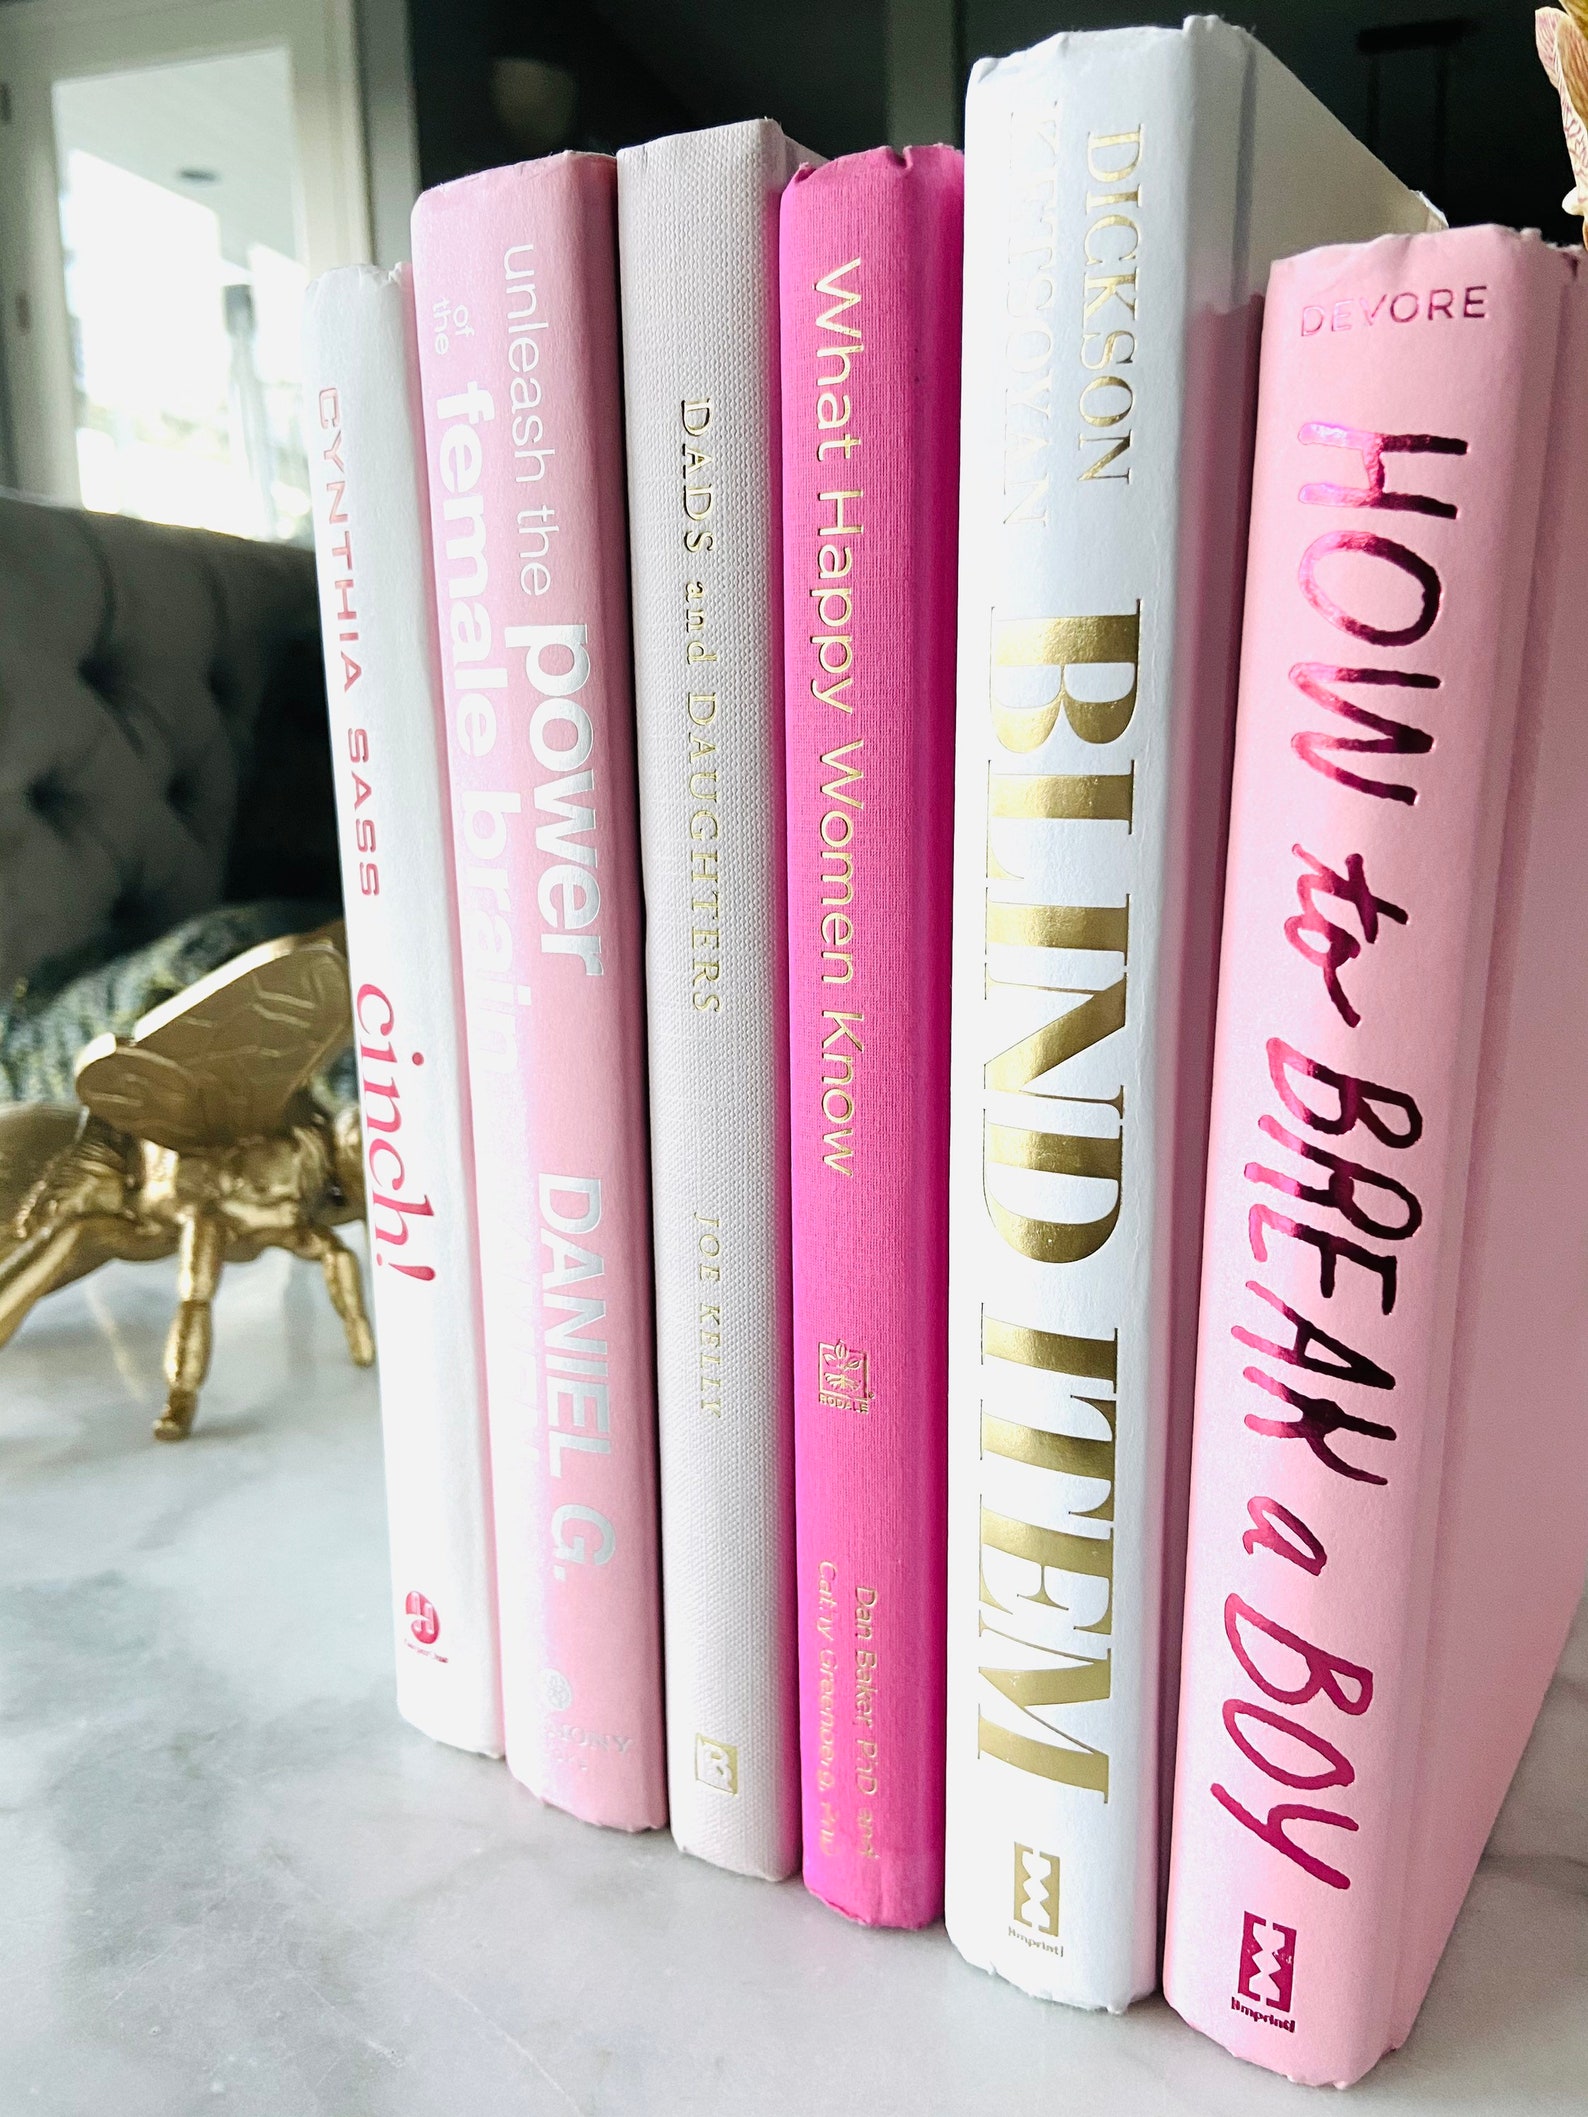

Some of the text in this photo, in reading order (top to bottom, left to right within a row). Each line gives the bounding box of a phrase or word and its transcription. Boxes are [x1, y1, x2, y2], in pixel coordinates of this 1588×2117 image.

[431, 296, 450, 356] the
[450, 304, 475, 338] of
[1076, 123, 1145, 485] DICKSON
[1300, 285, 1489, 338] DEVORE
[318, 388, 380, 896] CYNTHIA SASS
[437, 380, 532, 1075] female brain
[503, 243, 604, 976] unleash the power
[681, 397, 720, 1013] DADS and DAUGHTERS
[810, 257, 865, 1178] What Happy Women Know
[1288, 421, 1470, 807] HOW
[1284, 843, 1410, 1029] to
[356, 983, 436, 1282] cinch!
[693, 1211, 722, 1418] JOE KELLY
[978, 598, 1142, 1804] BLIND ITEM
[1230, 1036, 1424, 1486] BREAK
[538, 1172, 617, 1581] DANIEL G.
[1242, 1495, 1328, 1577] a
[855, 1585, 879, 1640] Dan
